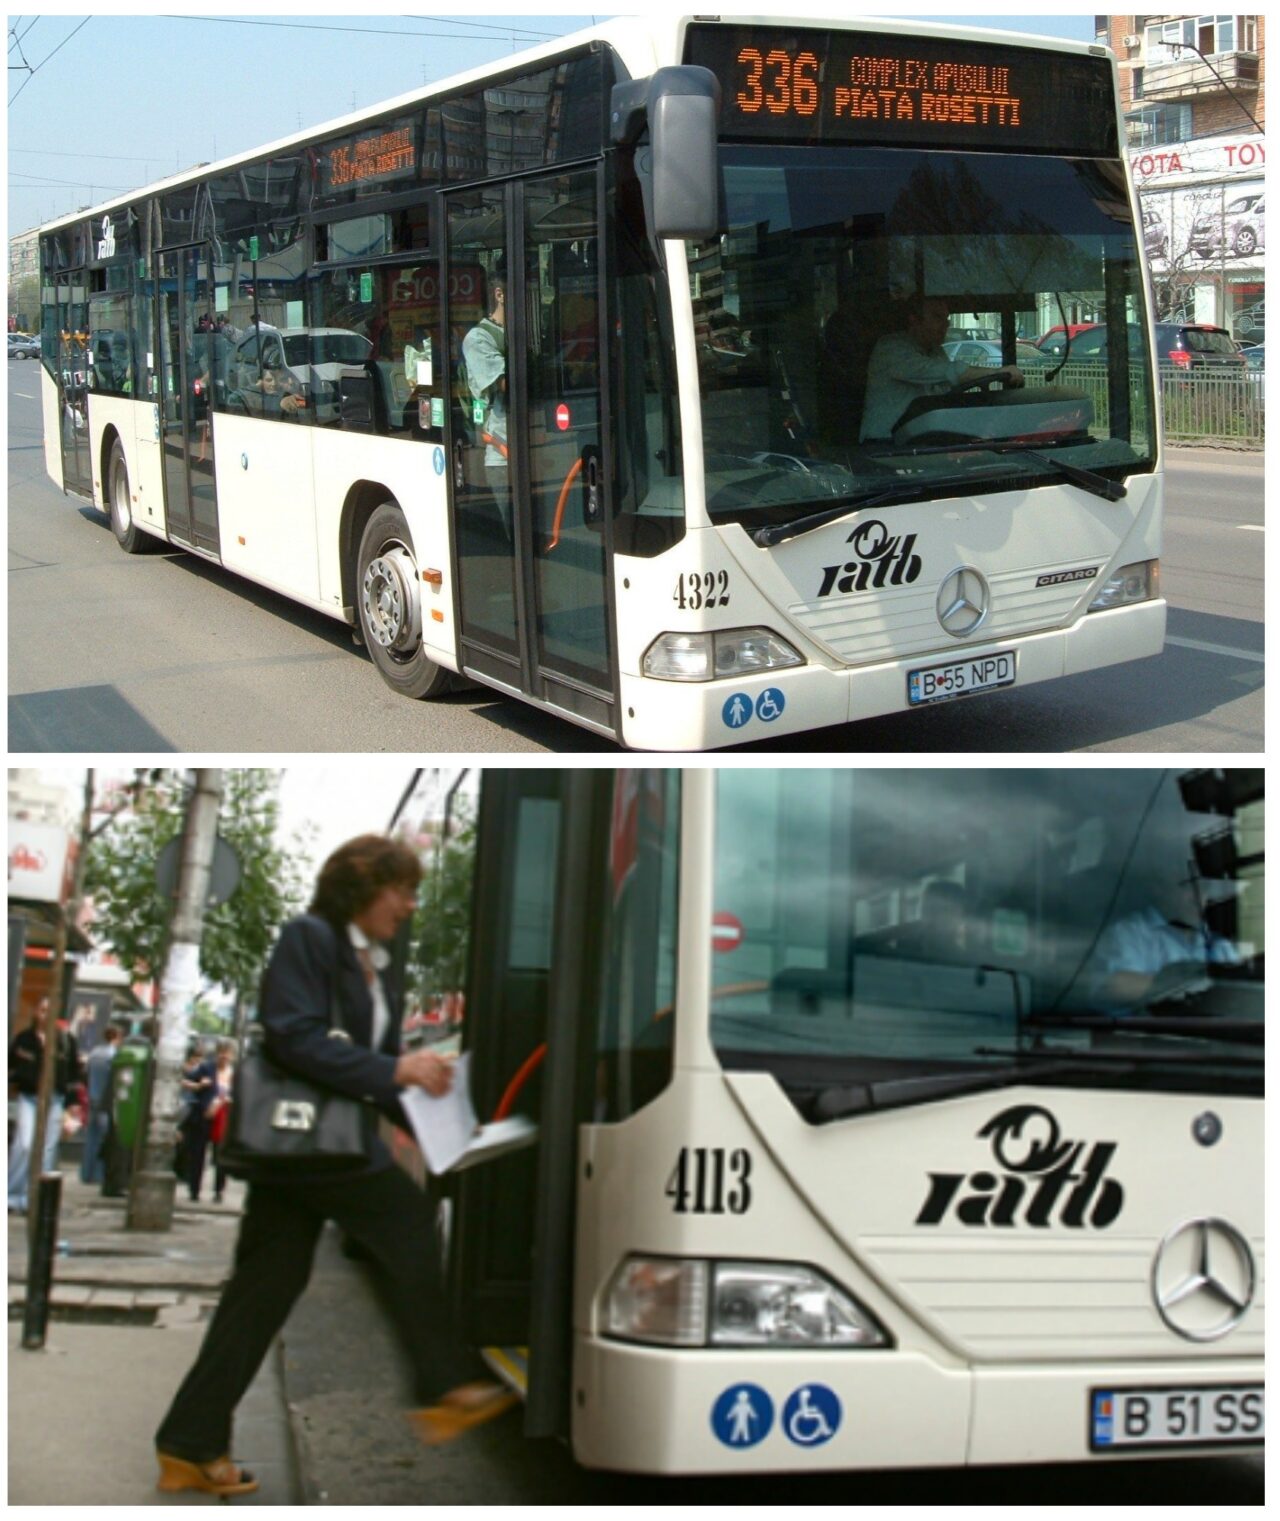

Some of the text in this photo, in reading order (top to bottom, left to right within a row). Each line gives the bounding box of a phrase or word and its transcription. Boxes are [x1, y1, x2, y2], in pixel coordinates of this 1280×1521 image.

[737, 47, 818, 115] 336
[850, 56, 1010, 95] COMPLEX APUSULUI
[835, 87, 1020, 126] PIATA ROSETTI
[817, 528, 922, 598] ratb
[1038, 568, 1097, 585] CITARO
[672, 569, 731, 610] 4322
[923, 672, 937, 696] B
[943, 667, 965, 690] 55
[972, 657, 1008, 685] NPD
[664, 1146, 753, 1215] 4113
[914, 1127, 1126, 1229] ratb
[1124, 1393, 1263, 1437] B 51 SS
